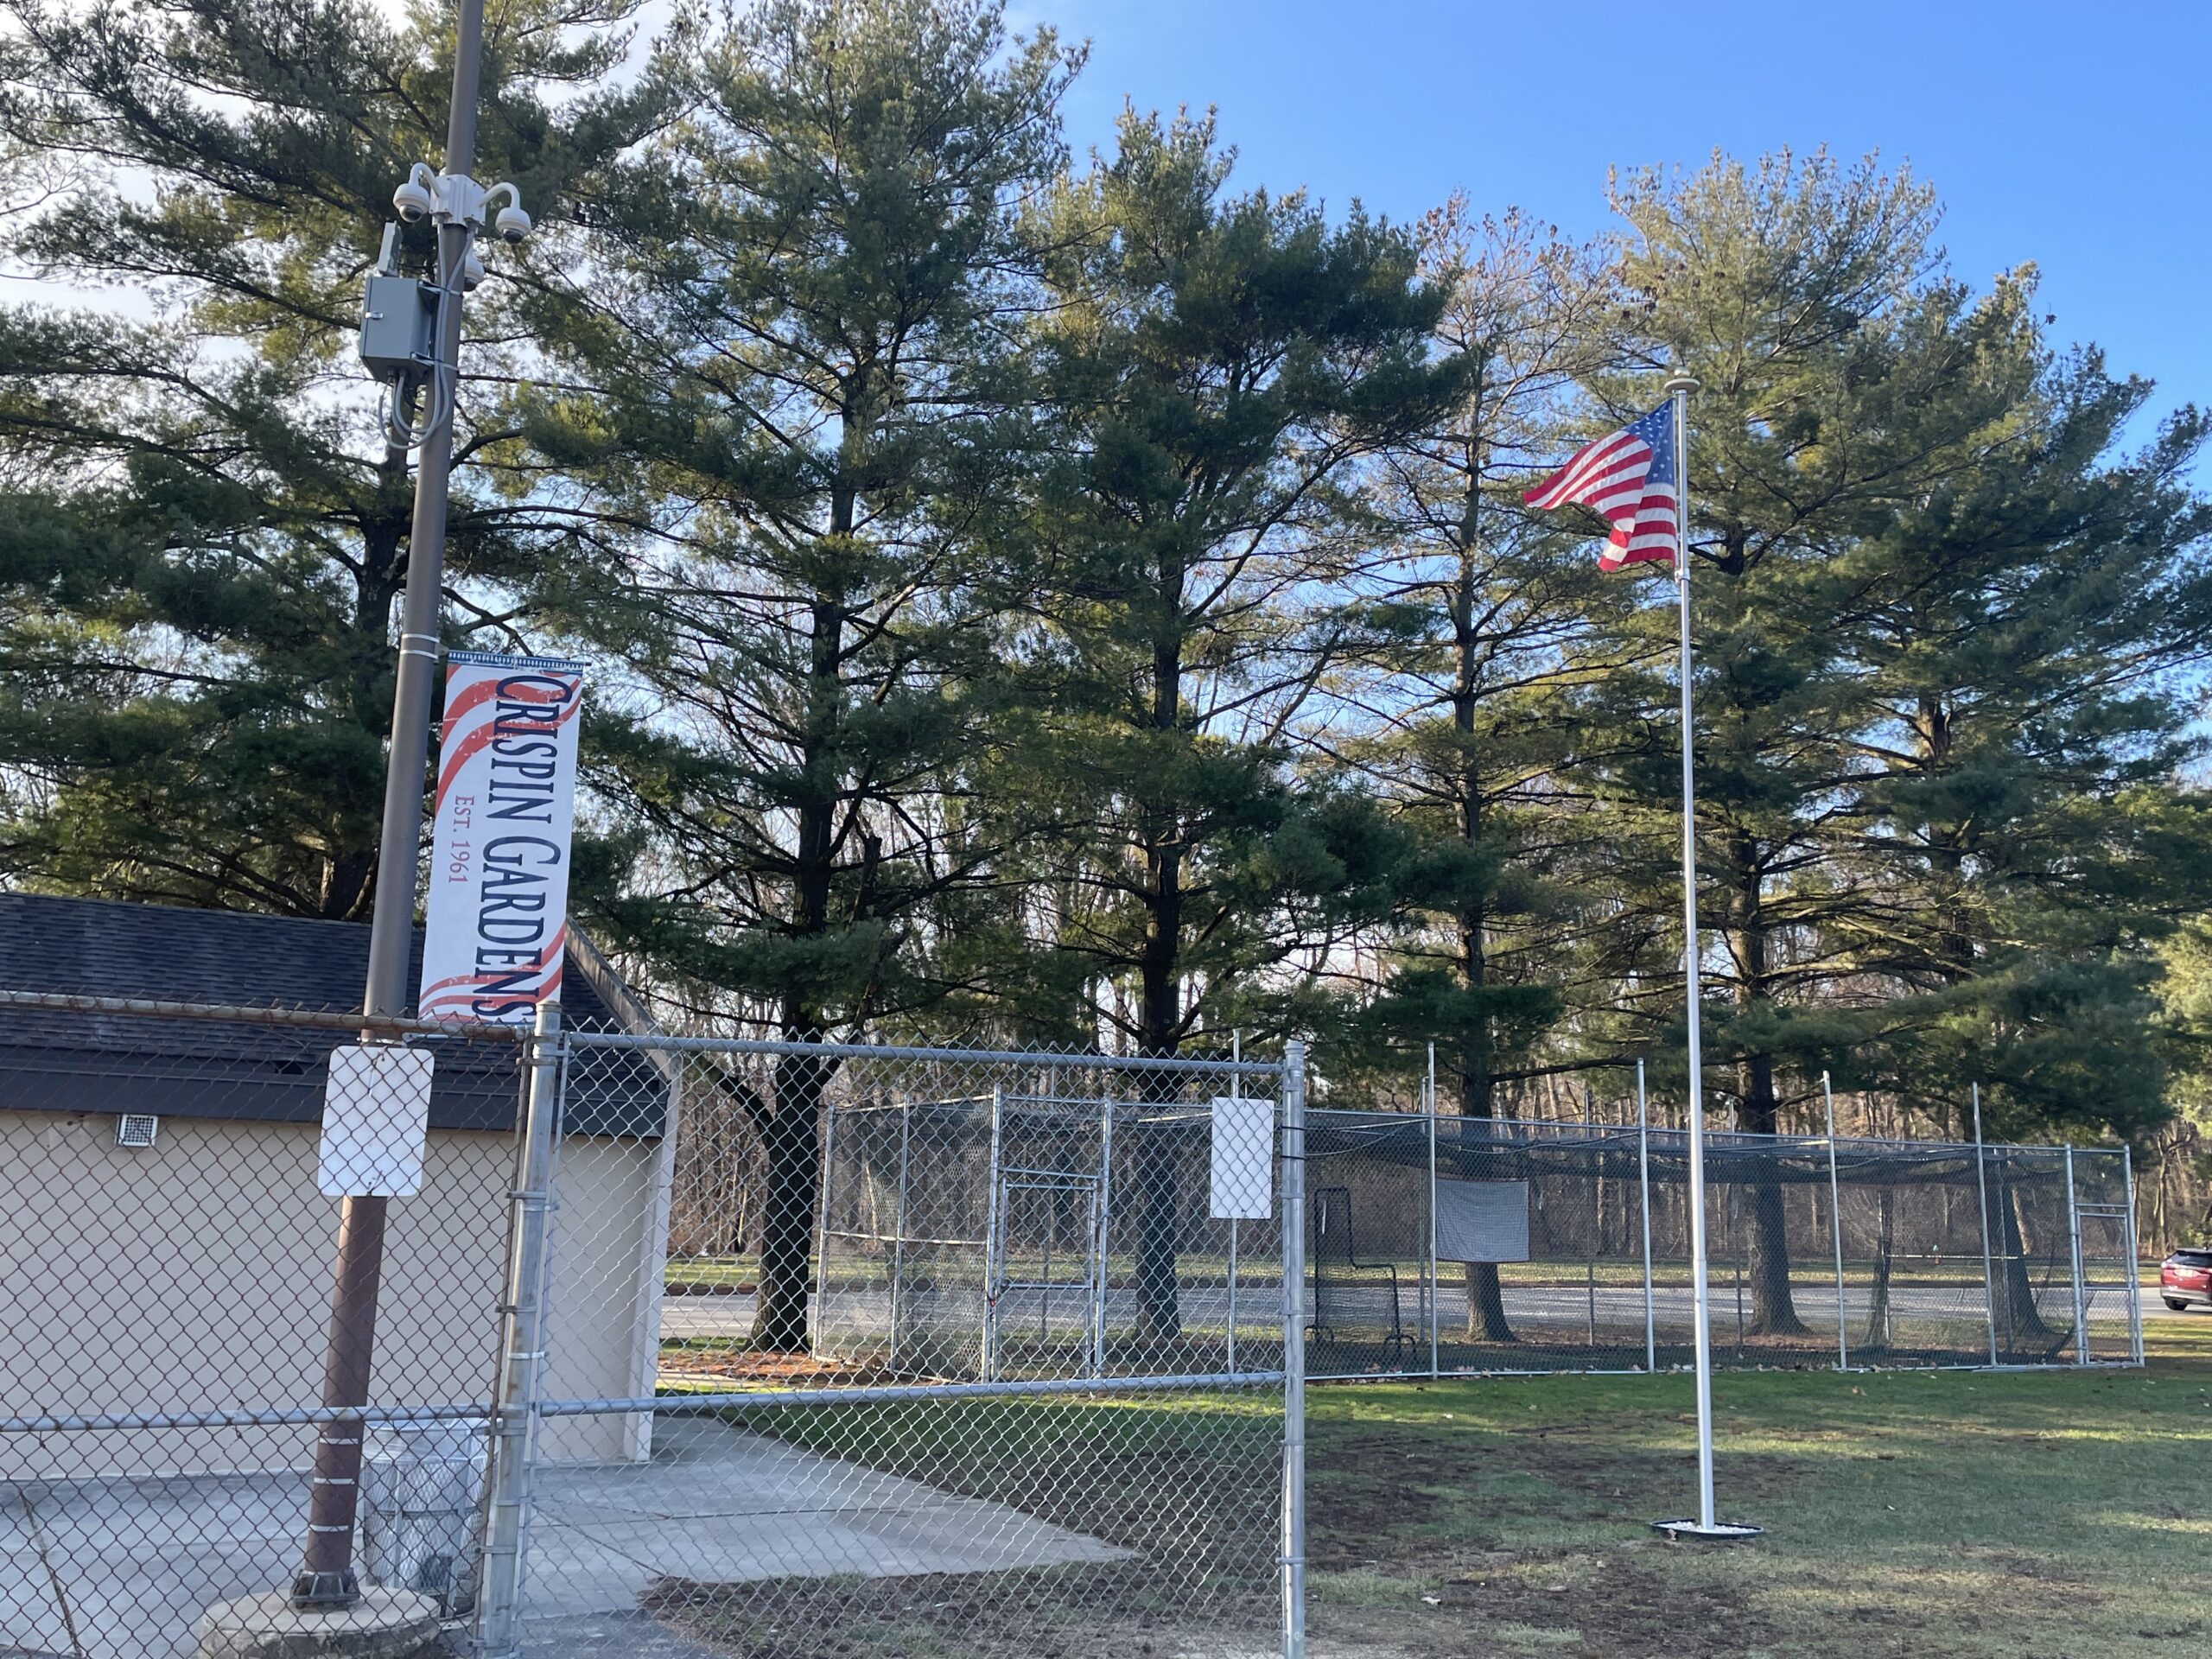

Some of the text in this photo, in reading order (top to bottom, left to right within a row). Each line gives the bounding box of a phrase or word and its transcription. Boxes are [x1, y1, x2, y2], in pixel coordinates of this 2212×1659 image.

[448, 795, 474, 884] EST. 1961
[471, 676, 573, 1017] CRISPIN GARDENS
